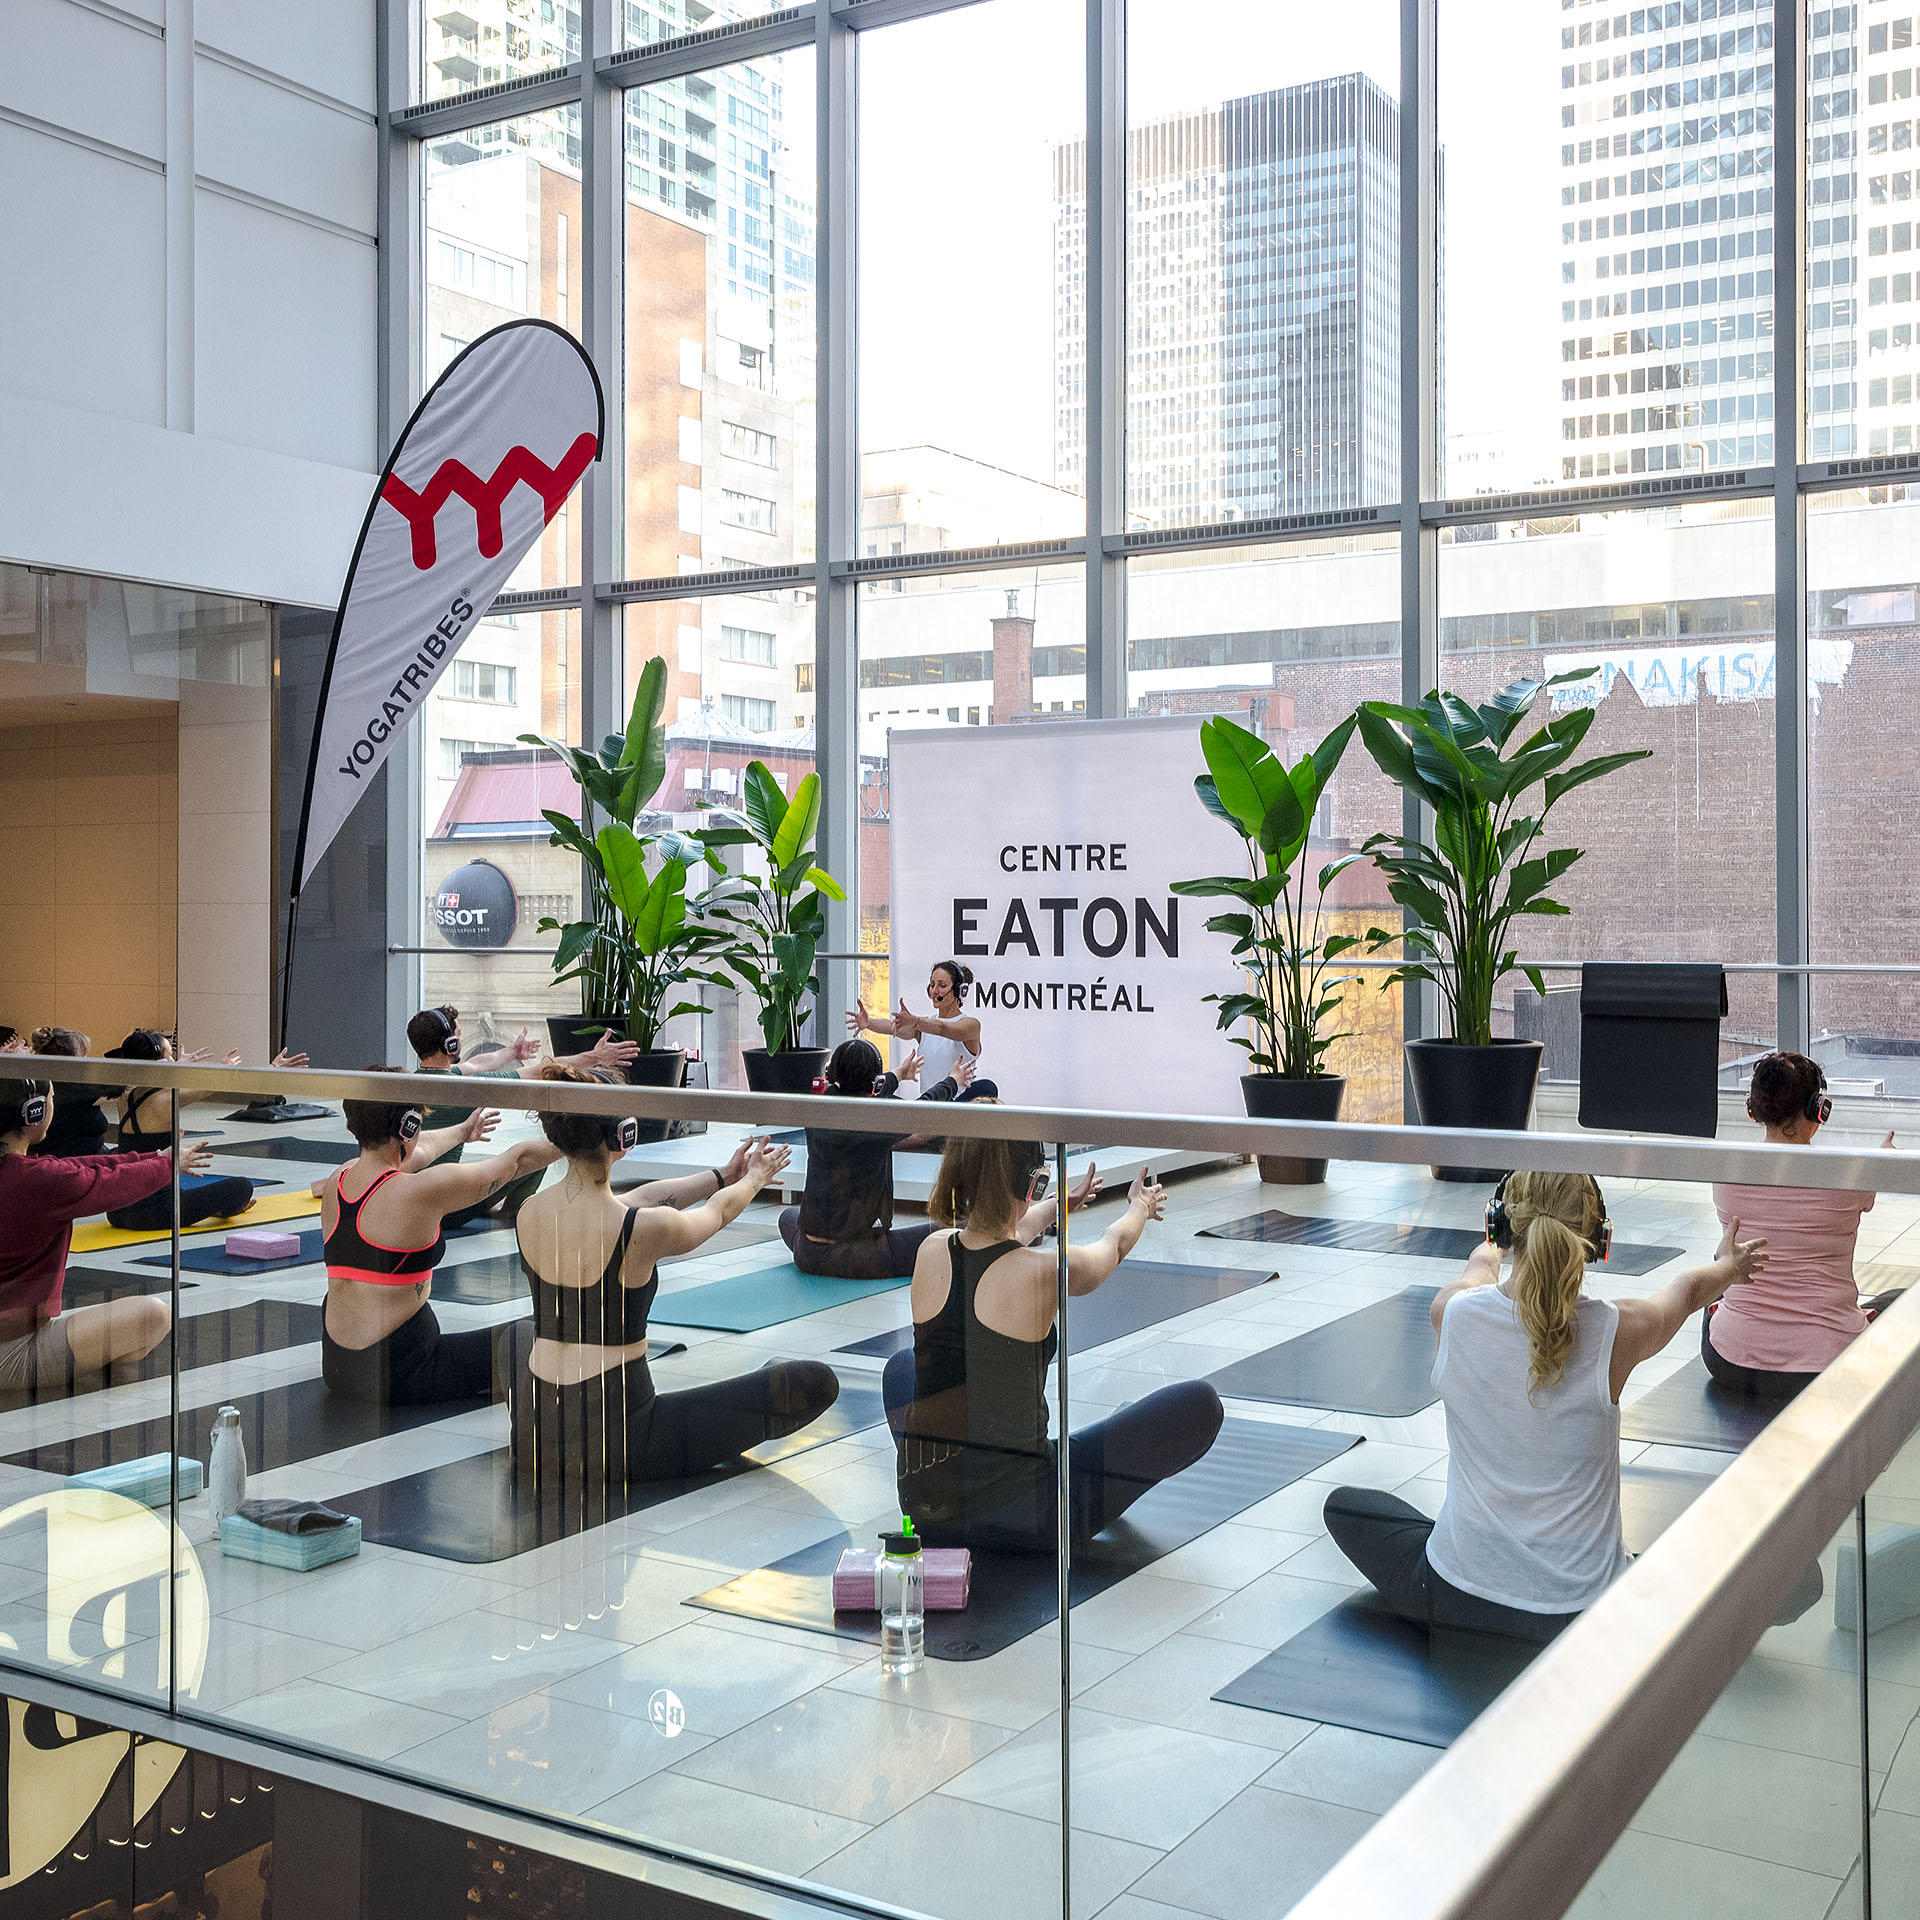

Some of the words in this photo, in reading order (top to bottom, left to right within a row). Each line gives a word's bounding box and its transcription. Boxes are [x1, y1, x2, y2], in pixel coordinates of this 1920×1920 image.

[1000, 843, 1127, 872] CENTRE
[434, 908, 488, 925] SSOT
[953, 897, 1179, 958] EATON
[975, 977, 1154, 1012] MONTRÉAL
